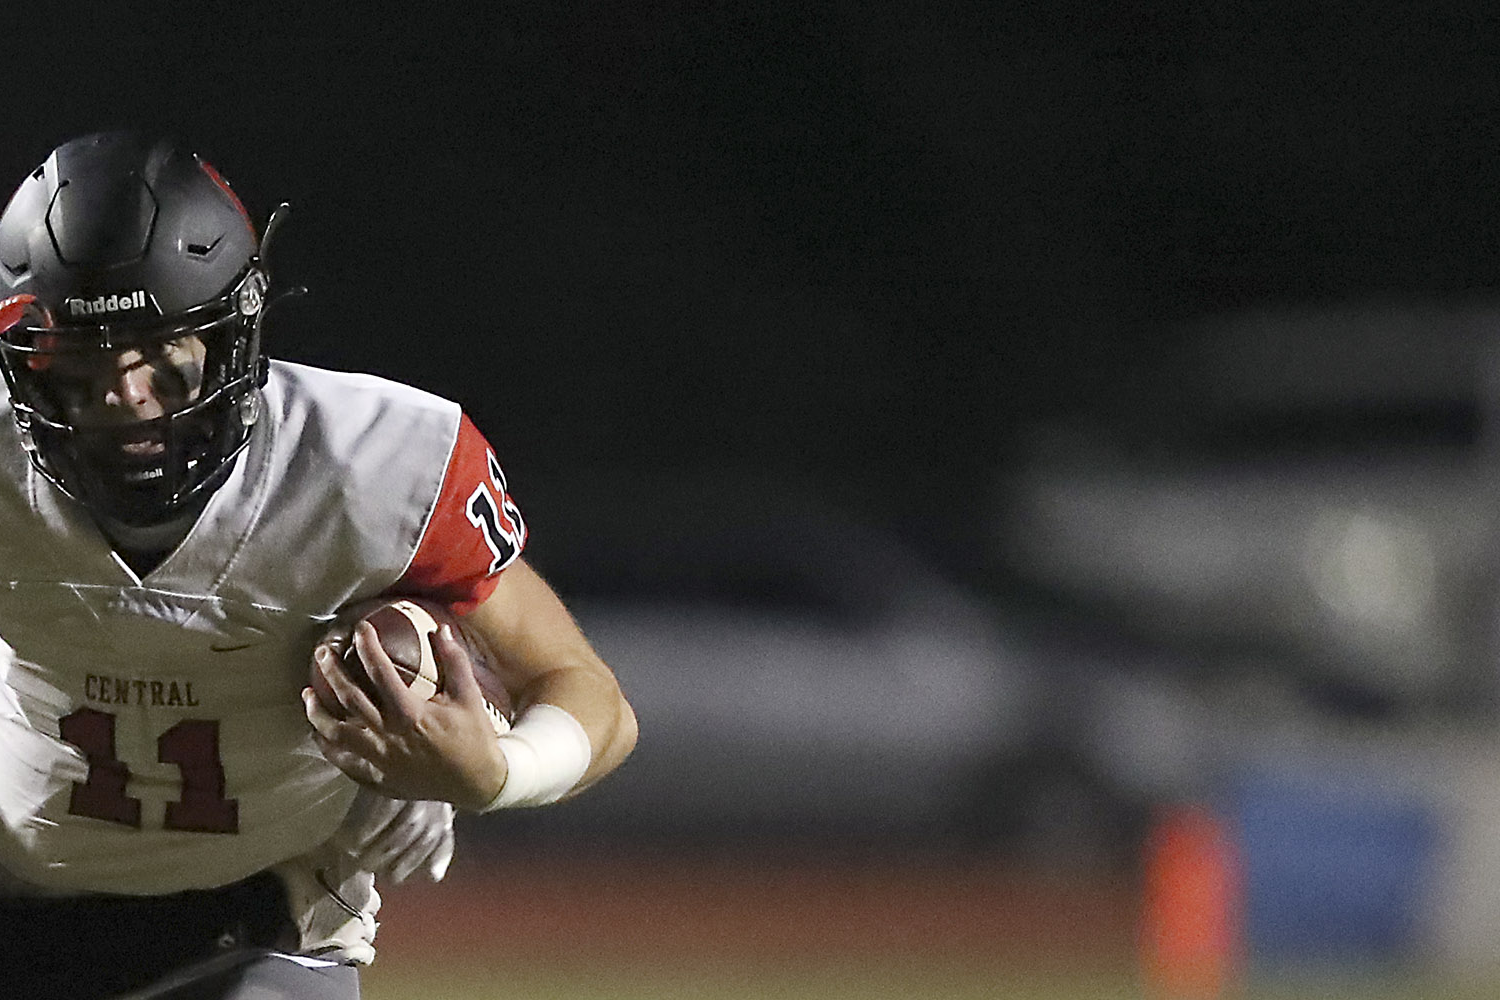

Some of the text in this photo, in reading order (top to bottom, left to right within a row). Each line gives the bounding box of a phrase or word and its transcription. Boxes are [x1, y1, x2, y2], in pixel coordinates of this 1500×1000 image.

[69, 290, 146, 316] Riddell
[84, 672, 201, 707] CENTRAL
[57, 705, 240, 835] 11
